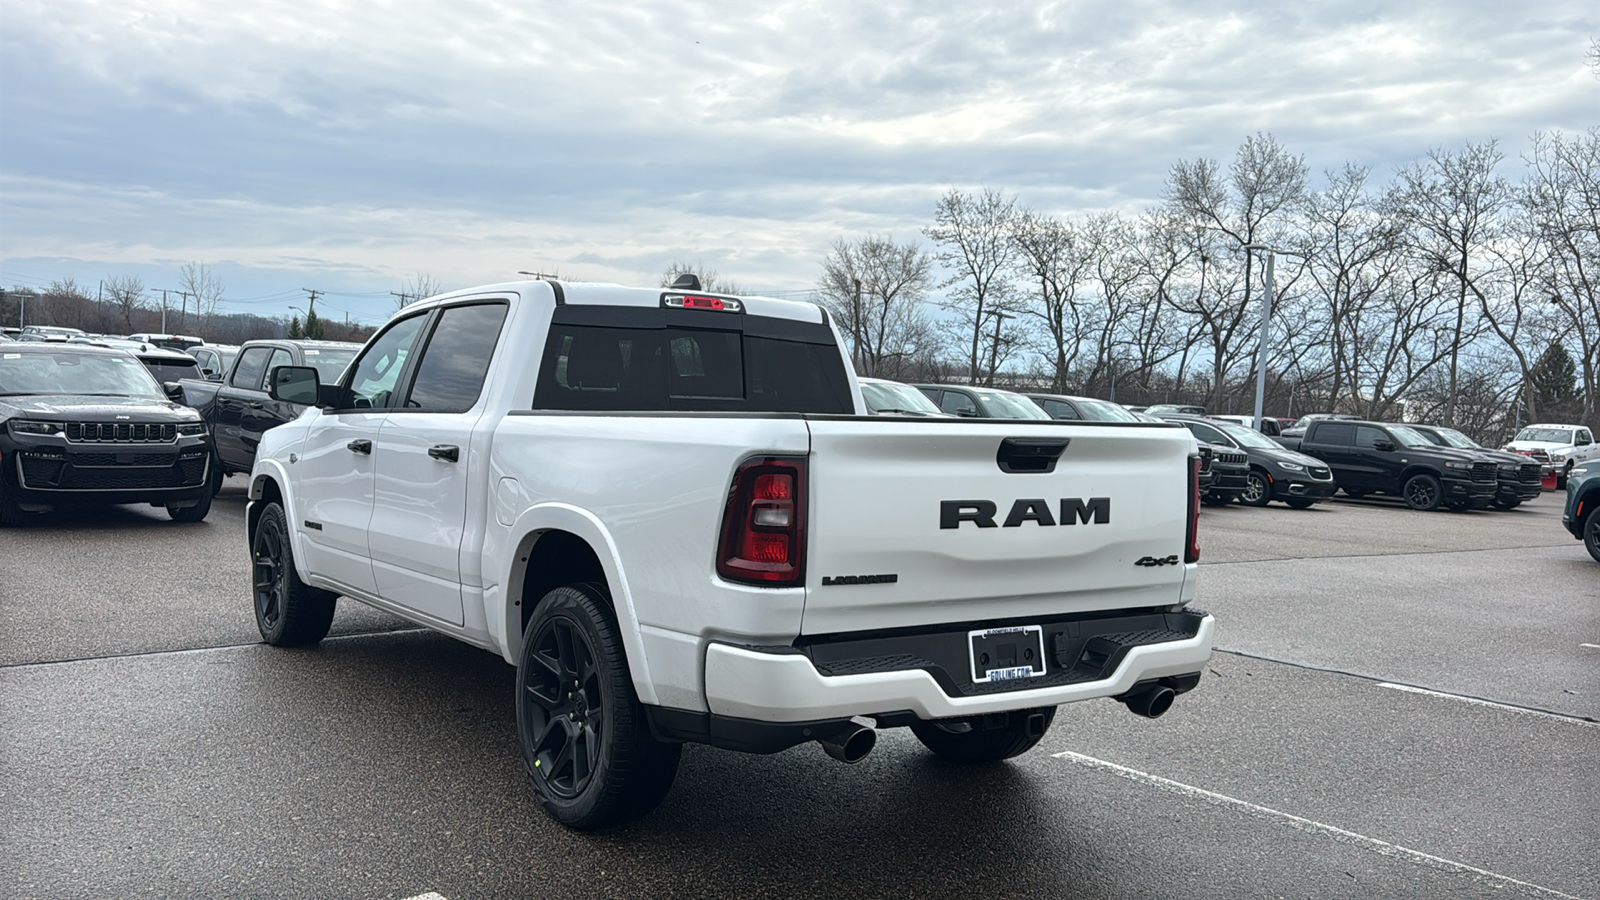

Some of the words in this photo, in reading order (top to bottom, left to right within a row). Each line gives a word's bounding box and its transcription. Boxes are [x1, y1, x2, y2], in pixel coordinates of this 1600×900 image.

[939, 497, 1110, 530] RAM
[1134, 554, 1179, 567] 4x4
[990, 667, 1030, 680] GOLLING.COM
